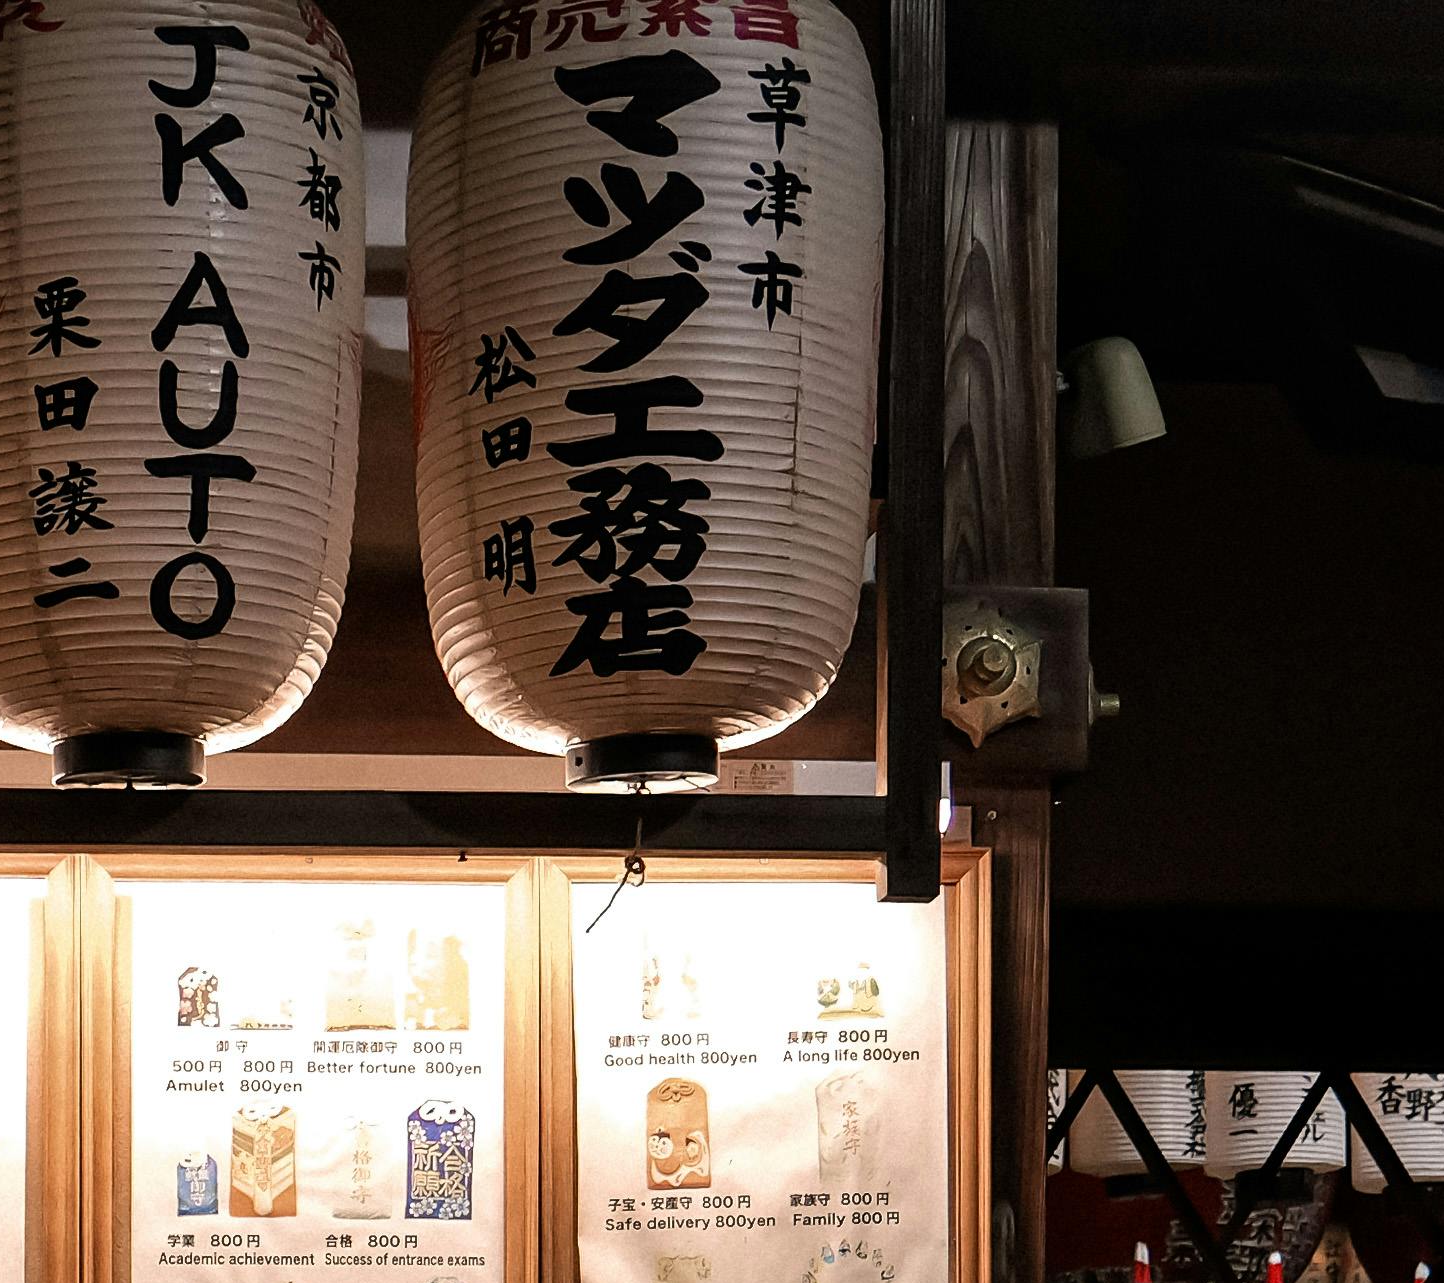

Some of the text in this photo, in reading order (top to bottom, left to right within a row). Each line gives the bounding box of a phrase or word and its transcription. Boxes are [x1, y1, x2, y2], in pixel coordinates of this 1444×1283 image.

[296, 67, 344, 311] 京都市
[738, 58, 813, 332] 草津市
[549, 49, 723, 679] マツダ工務店
[468, 328, 537, 598] 松田明
[604, 1051, 757, 1067] Good health 800yen
[783, 1048, 920, 1065] A long life 800yen
[307, 1062, 482, 1075] Better fortune 800yen
[166, 1080, 302, 1095] Amulet 800yen
[1229, 1083, 1258, 1136] 優一
[790, 1194, 830, 1207] 家族守
[606, 1215, 776, 1231] Safe delivery 800yen
[793, 1214, 845, 1228] Family
[168, 1235, 194, 1247] 学業
[326, 1235, 352, 1247] 合格
[159, 1253, 315, 1266] Academic achievement
[325, 1254, 485, 1266] Success of entrance exams
